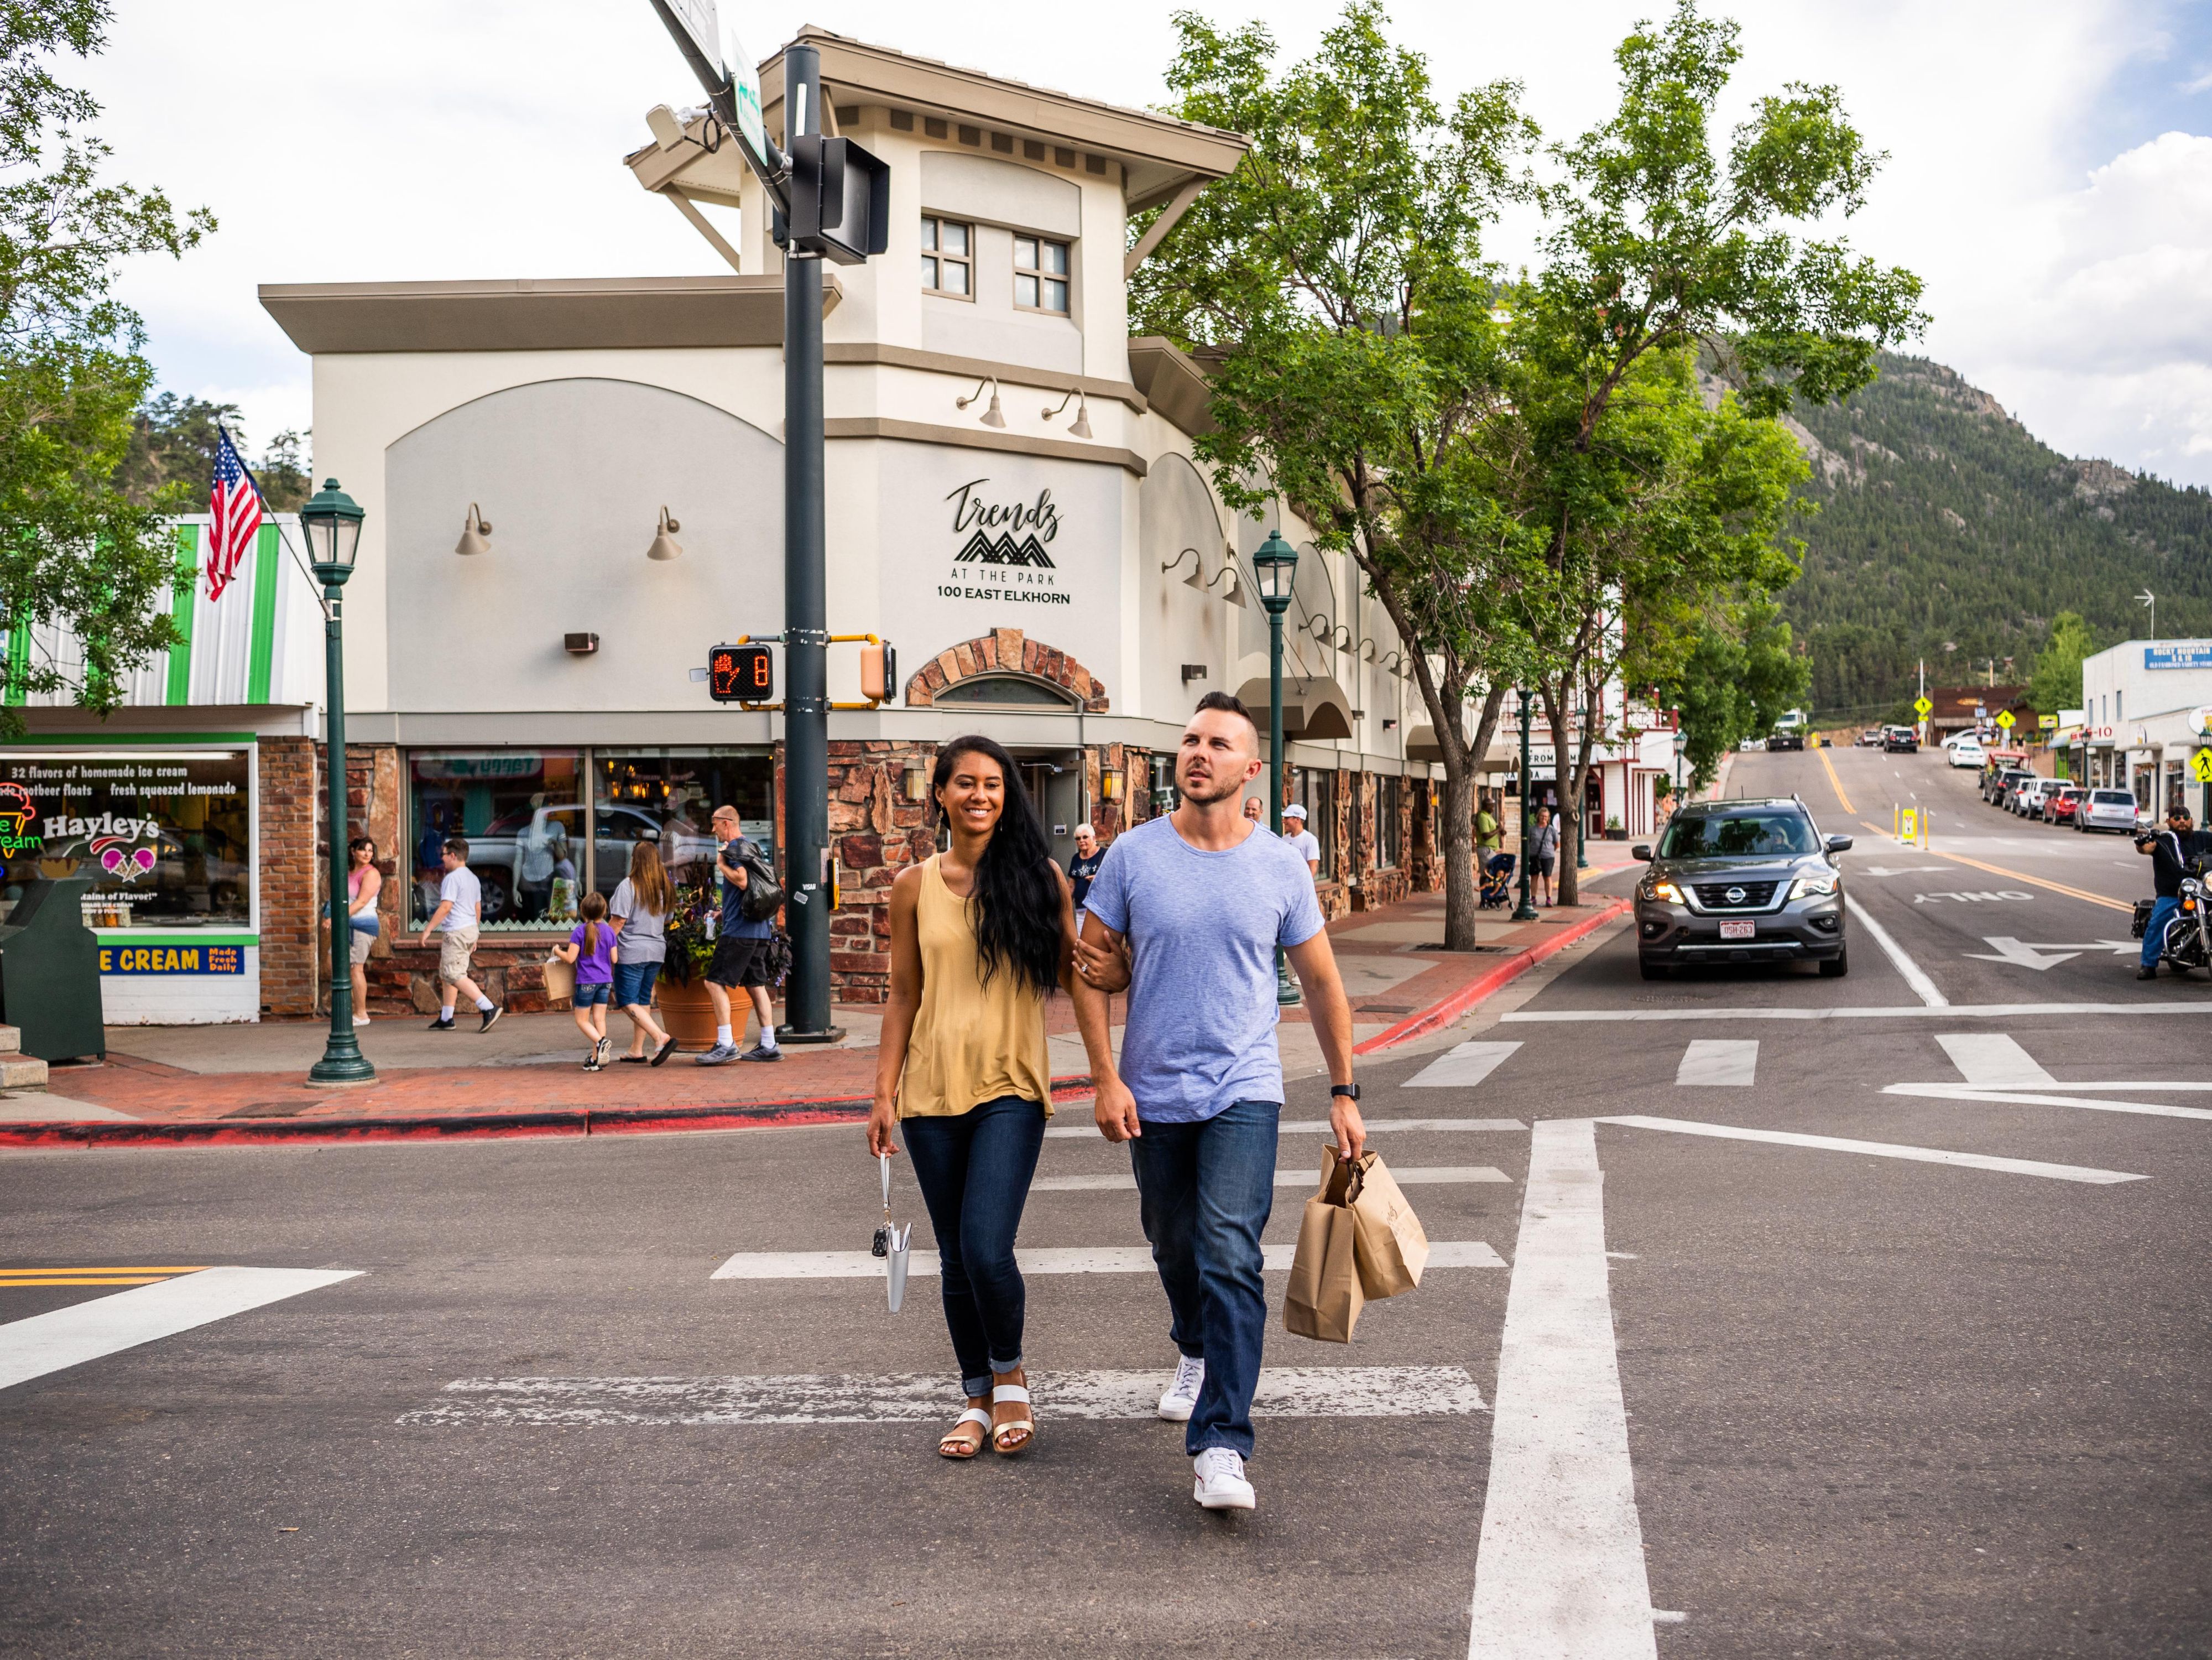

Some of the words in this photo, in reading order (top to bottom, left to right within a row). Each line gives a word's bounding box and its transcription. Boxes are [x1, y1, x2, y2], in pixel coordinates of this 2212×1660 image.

[947, 478, 1064, 543] Trendz
[951, 568, 967, 579] AT
[980, 570, 1006, 582] THE
[1018, 573, 1055, 586] PARK
[938, 586, 962, 597] 100
[965, 588, 1001, 600] EAST
[1005, 590, 1070, 604] ELKHORN
[12, 767, 25, 779] 32
[29, 766, 63, 779] flavors
[66, 765, 77, 778] of
[81, 764, 135, 778] homemade
[138, 764, 153, 777] ice
[156, 767, 188, 777] cream
[19, 783, 60, 796] rootbeer
[63, 783, 92, 796] floats
[110, 782, 137, 796] fresh
[139, 782, 185, 799] squeezed
[188, 780, 237, 795] lemonade
[43, 811, 160, 843] Hayley's
[81, 892, 106, 901] tains
[107, 892, 117, 901] of
[1914, 891, 2034, 903] ONLY
[119, 949, 199, 971] CREAM
[209, 964, 236, 973] Daily
